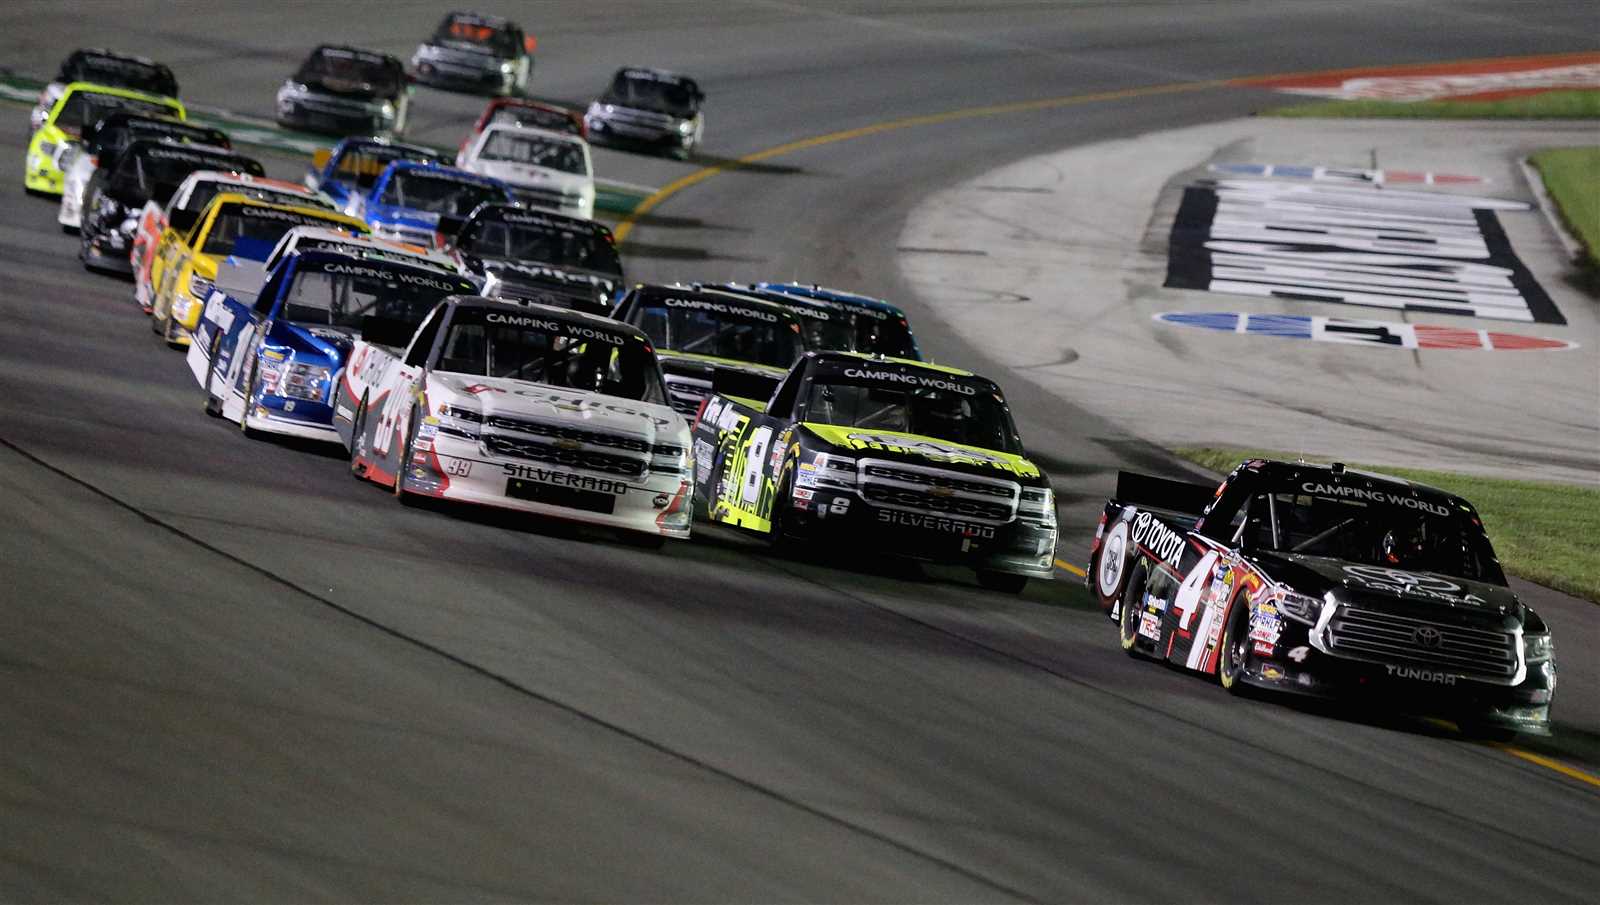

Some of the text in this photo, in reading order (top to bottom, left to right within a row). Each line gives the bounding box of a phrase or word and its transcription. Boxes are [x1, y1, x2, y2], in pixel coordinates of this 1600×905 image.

[323, 263, 454, 292] CAMPING WORLD
[664, 298, 778, 323] CAMPING WORLD
[784, 304, 830, 321] WORLD
[486, 312, 625, 346] CAMPING WORLD
[843, 368, 976, 396] CAMPING WORLD
[447, 459, 472, 478] 99
[503, 462, 628, 495] SILVERADO
[830, 496, 851, 515] 8
[1301, 482, 1451, 517] CAMPING WORLD
[878, 509, 996, 540] SILVERADO
[1145, 517, 1187, 570] TOYOTA
[1174, 549, 1220, 631] 4
[1287, 646, 1311, 663] 4
[1385, 664, 1457, 686] TUNDRA
